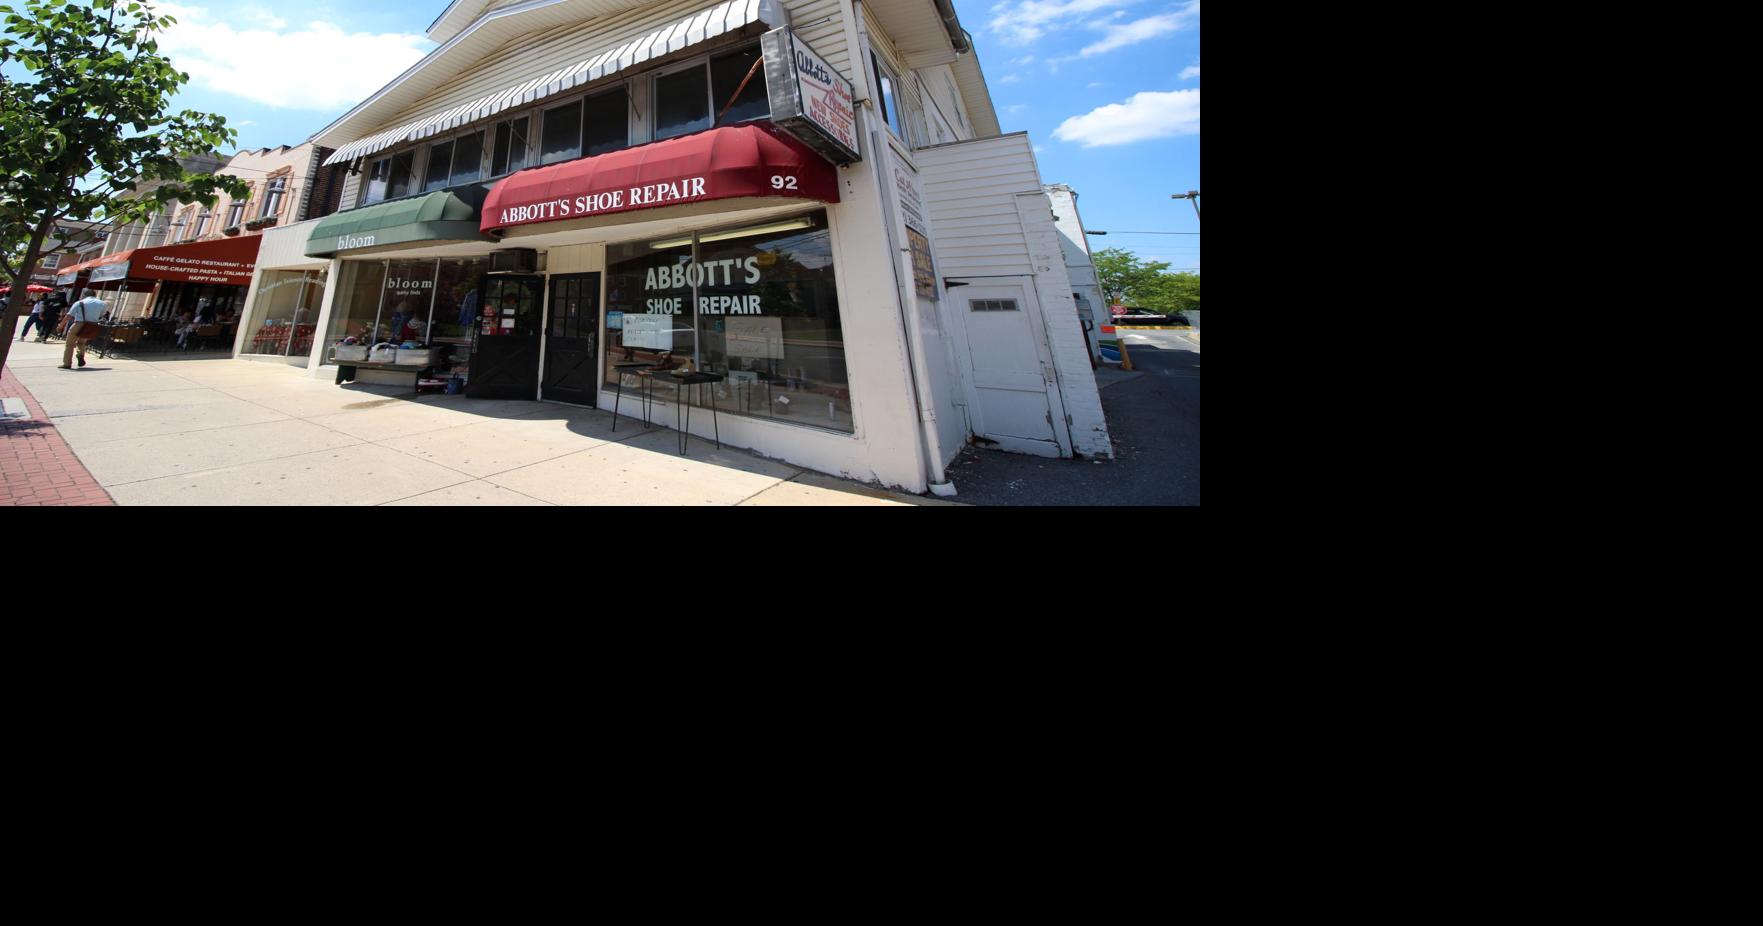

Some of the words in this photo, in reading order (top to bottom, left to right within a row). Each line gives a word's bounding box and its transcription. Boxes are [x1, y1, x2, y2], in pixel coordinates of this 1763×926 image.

[770, 175, 798, 190] 92
[500, 198, 570, 224] ABBOTT'S
[575, 190, 624, 214] SHOE
[629, 177, 706, 206] REPAIR
[337, 234, 375, 250] bloom
[145, 264, 199, 273] HOUSE-CRAFTED
[175, 257, 200, 265] GELATO
[201, 260, 240, 268] RESTAURANT
[644, 256, 761, 290] ABBOTT'S
[388, 277, 433, 289] bloom
[646, 297, 683, 315] SHOE
[699, 294, 762, 315] REPAIR
